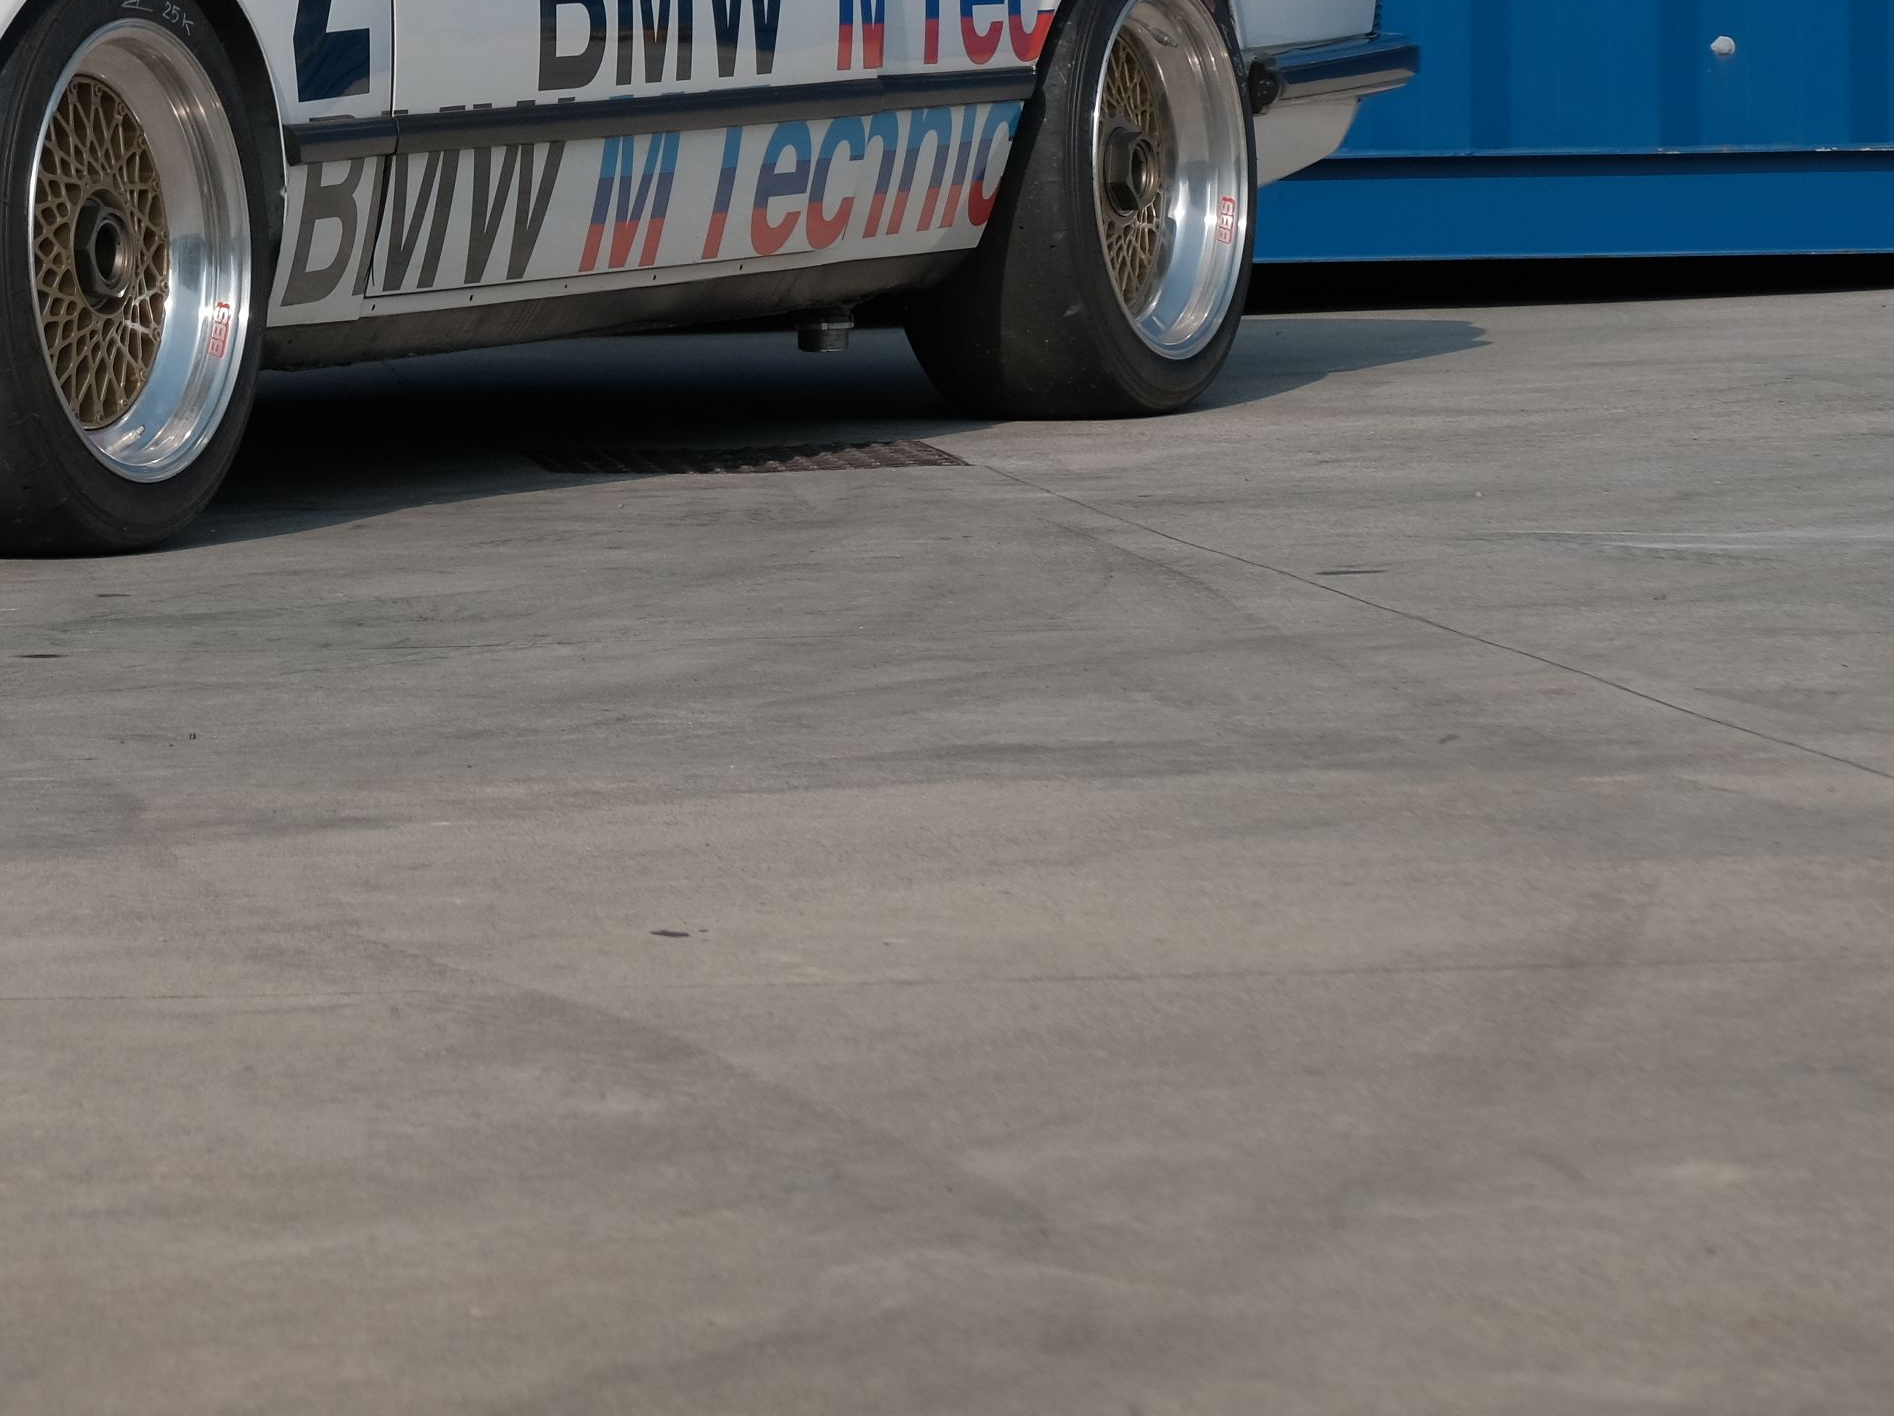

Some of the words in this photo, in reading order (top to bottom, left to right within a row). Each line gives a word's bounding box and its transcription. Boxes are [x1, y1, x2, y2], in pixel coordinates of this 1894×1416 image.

[280, 97, 576, 307] BMW
[577, 92, 685, 273] M
[1216, 196, 1236, 245] BBS
[207, 301, 231, 359] BBS
